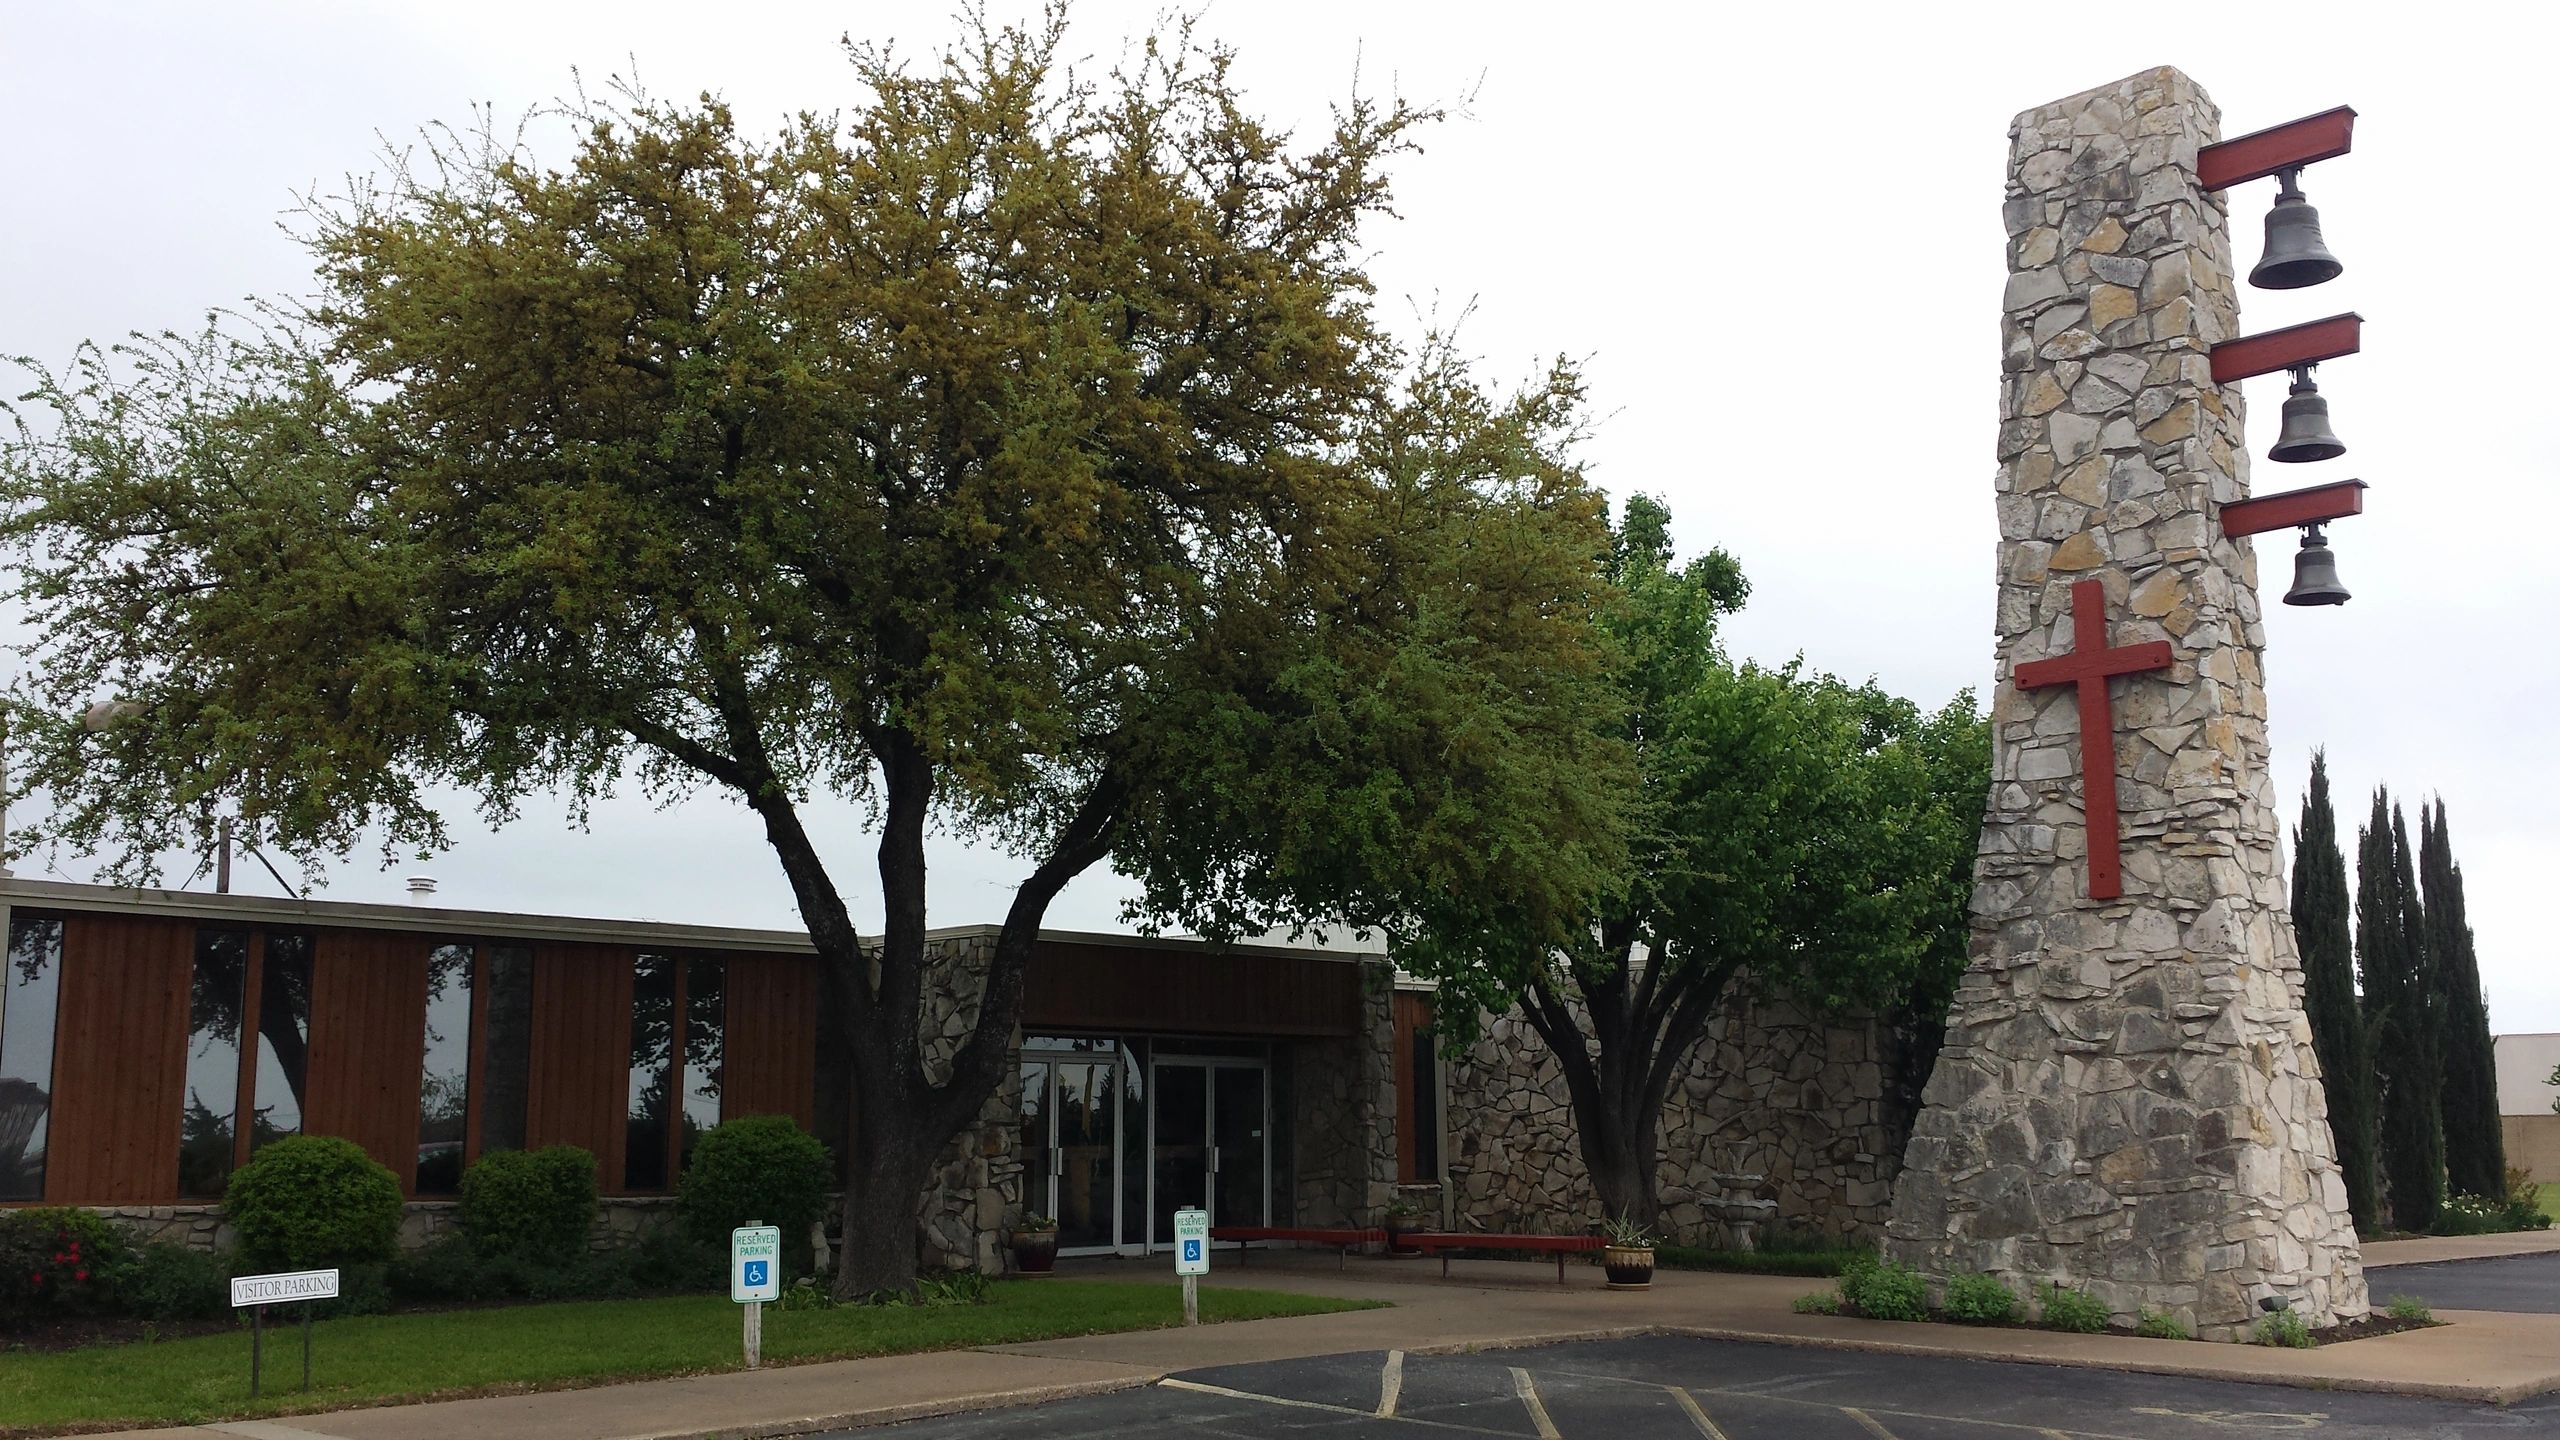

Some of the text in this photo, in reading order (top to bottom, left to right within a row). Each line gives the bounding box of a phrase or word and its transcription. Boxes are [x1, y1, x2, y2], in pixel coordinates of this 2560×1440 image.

[1177, 1216, 1205, 1225] RESERVED
[1180, 1226, 1203, 1235] PARKING
[736, 1234, 776, 1245] RESERVED
[740, 1245, 773, 1256] PARKING
[236, 1276, 334, 1299] VISITOR PARKING
